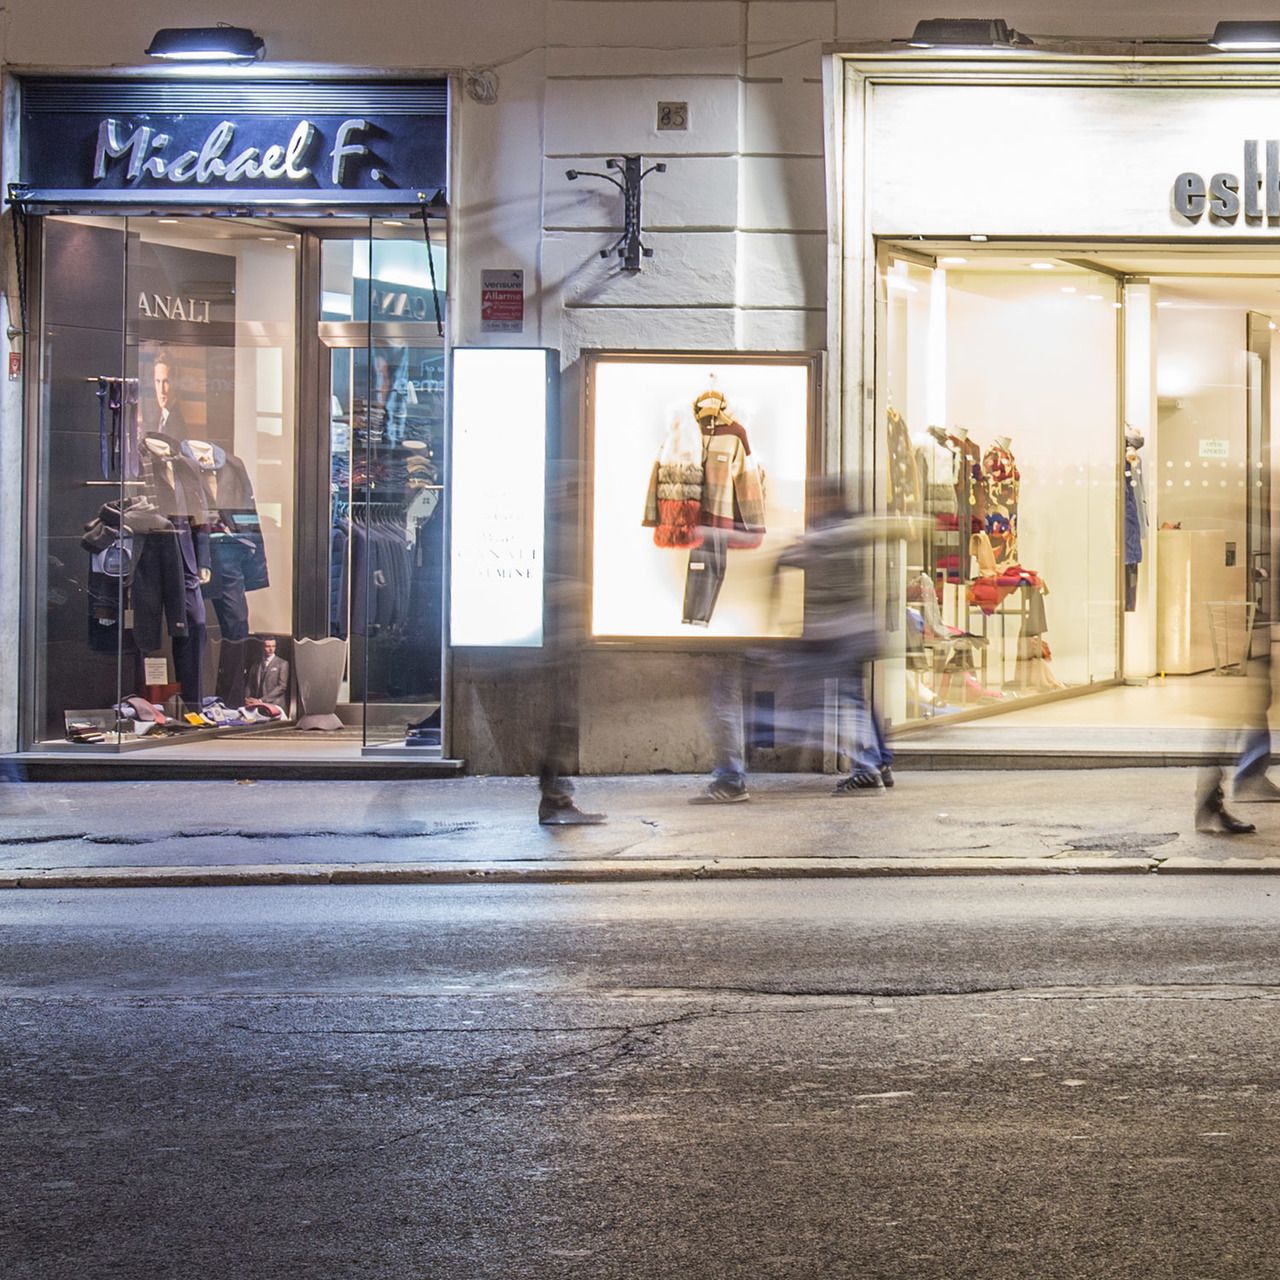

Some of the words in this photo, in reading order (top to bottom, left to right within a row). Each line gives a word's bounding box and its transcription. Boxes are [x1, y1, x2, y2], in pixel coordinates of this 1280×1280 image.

[660, 106, 686, 127] 85
[93, 118, 314, 184] Michael
[330, 118, 382, 185] F.
